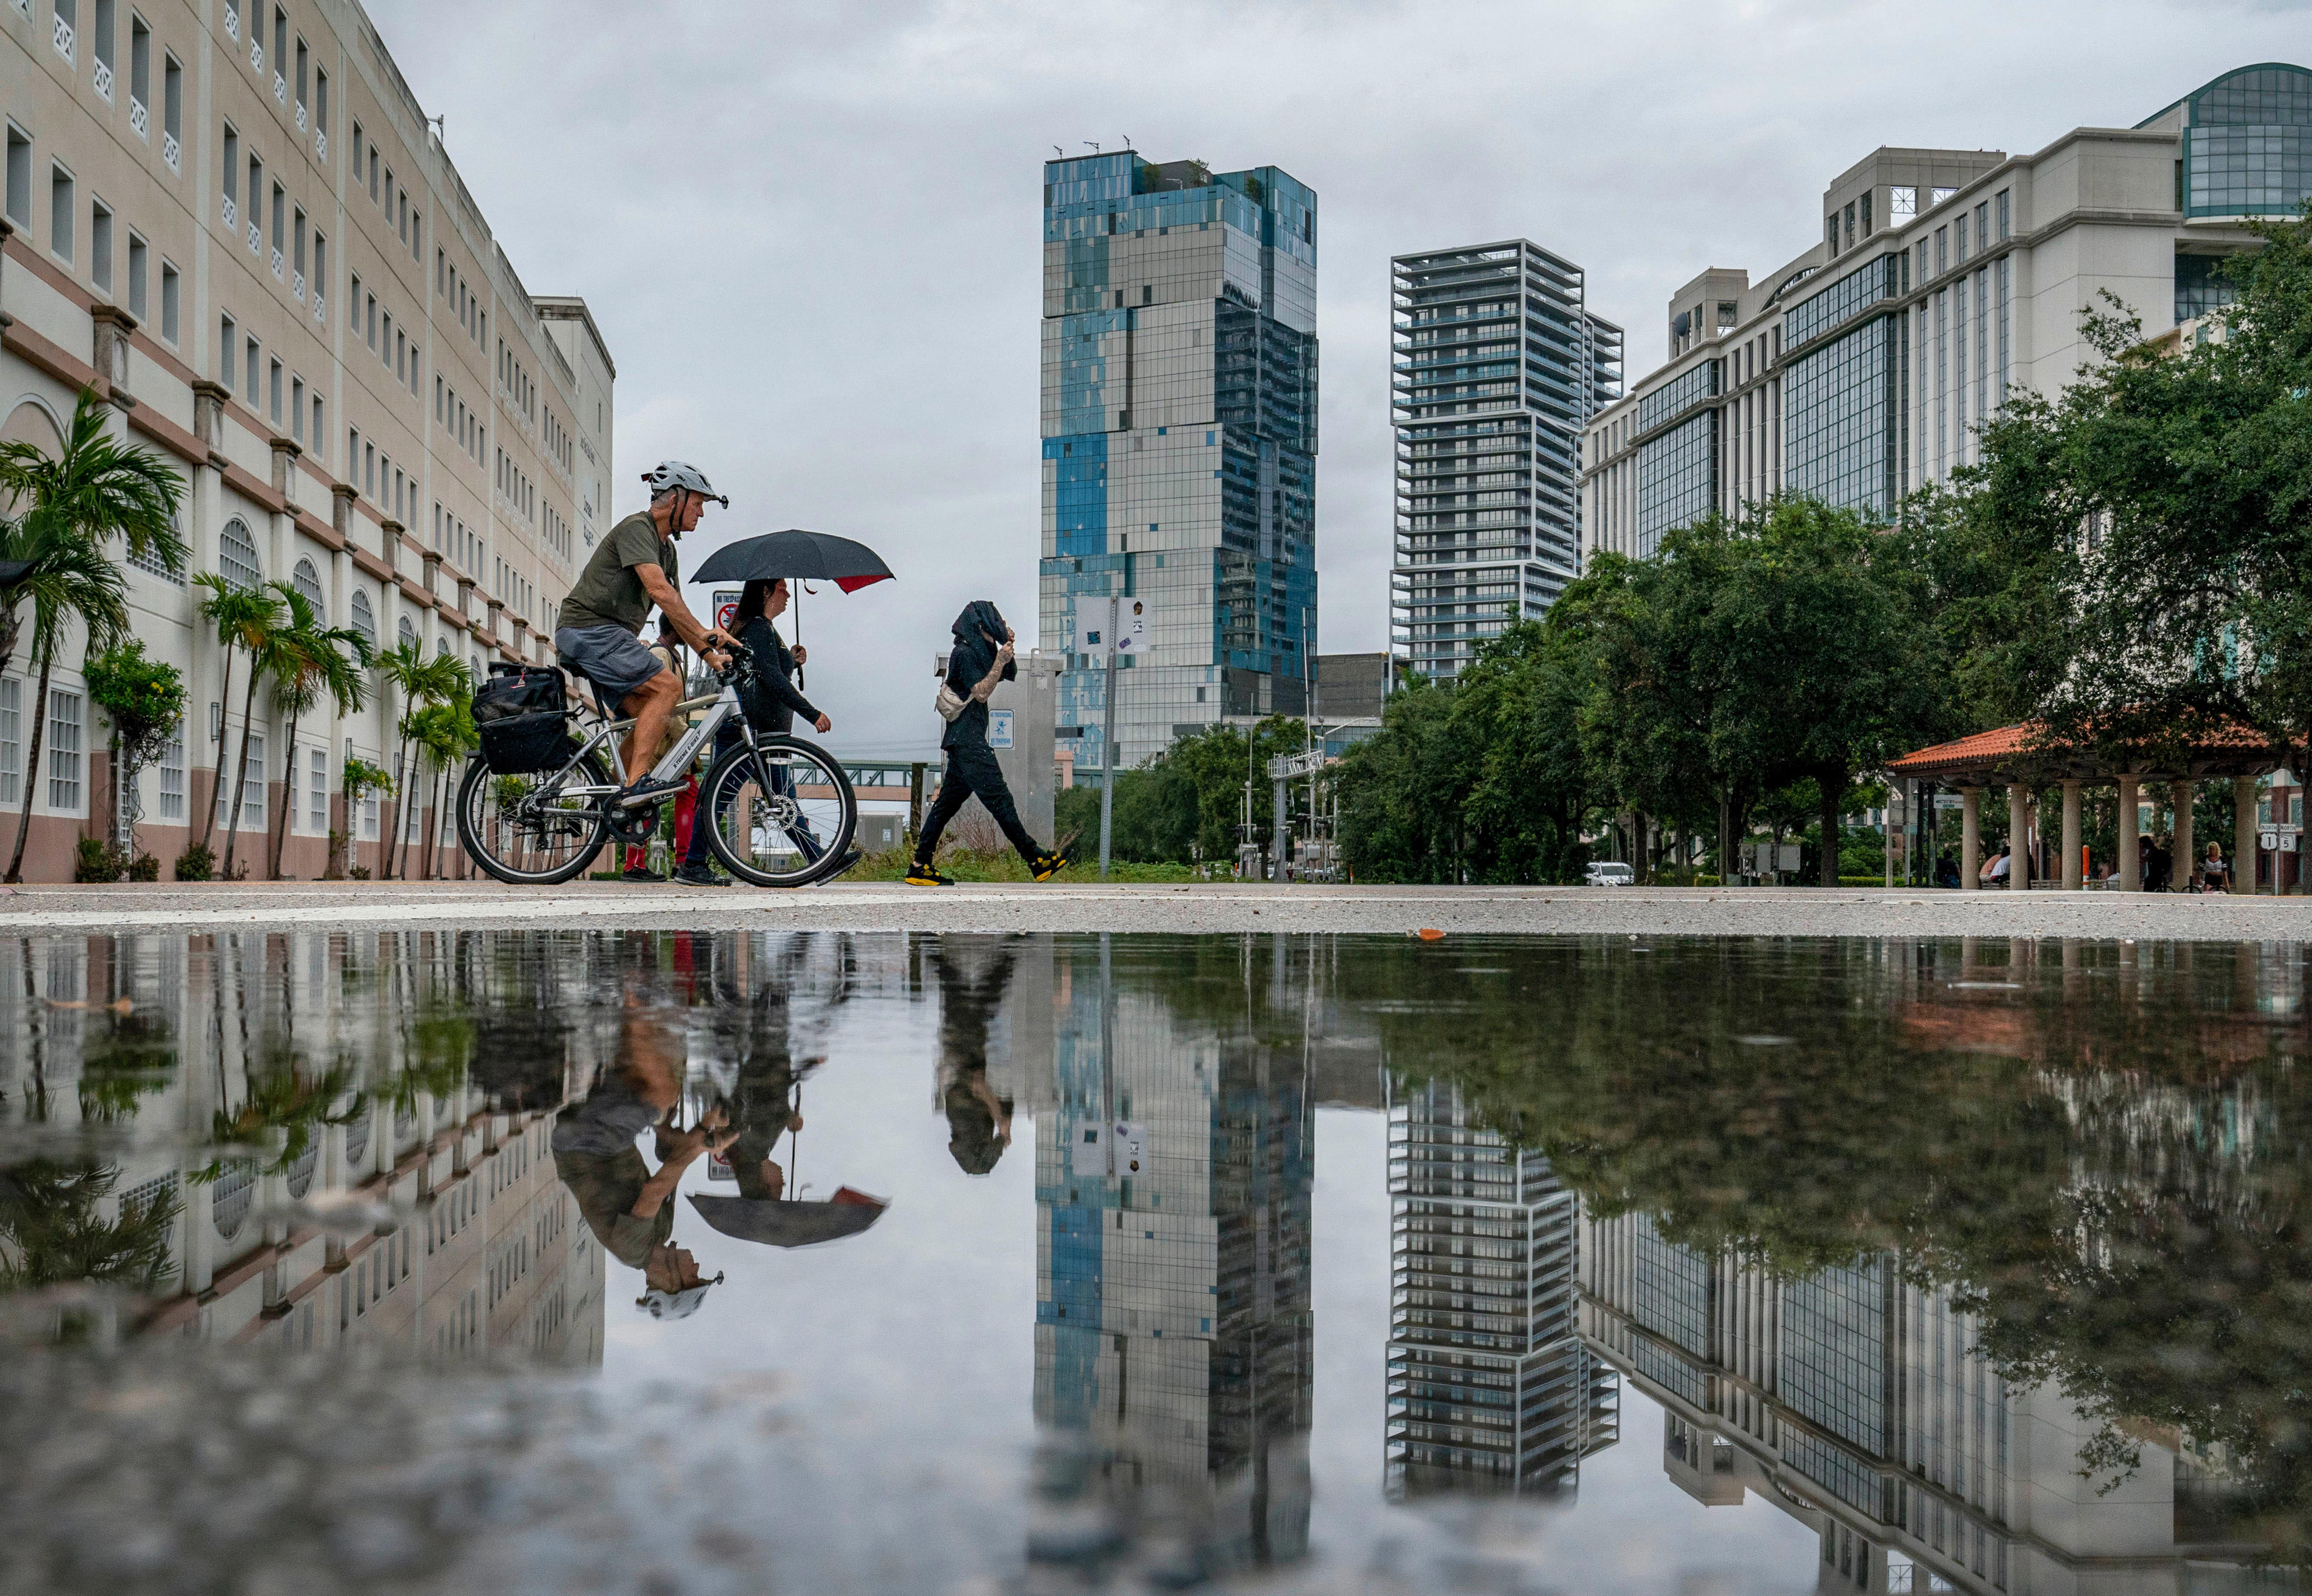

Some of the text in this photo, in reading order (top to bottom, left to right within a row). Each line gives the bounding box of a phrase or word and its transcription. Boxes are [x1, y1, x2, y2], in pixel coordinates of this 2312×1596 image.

[673, 735, 699, 769] X-TREME E-BIKE
[2267, 837, 2271, 847] 1
